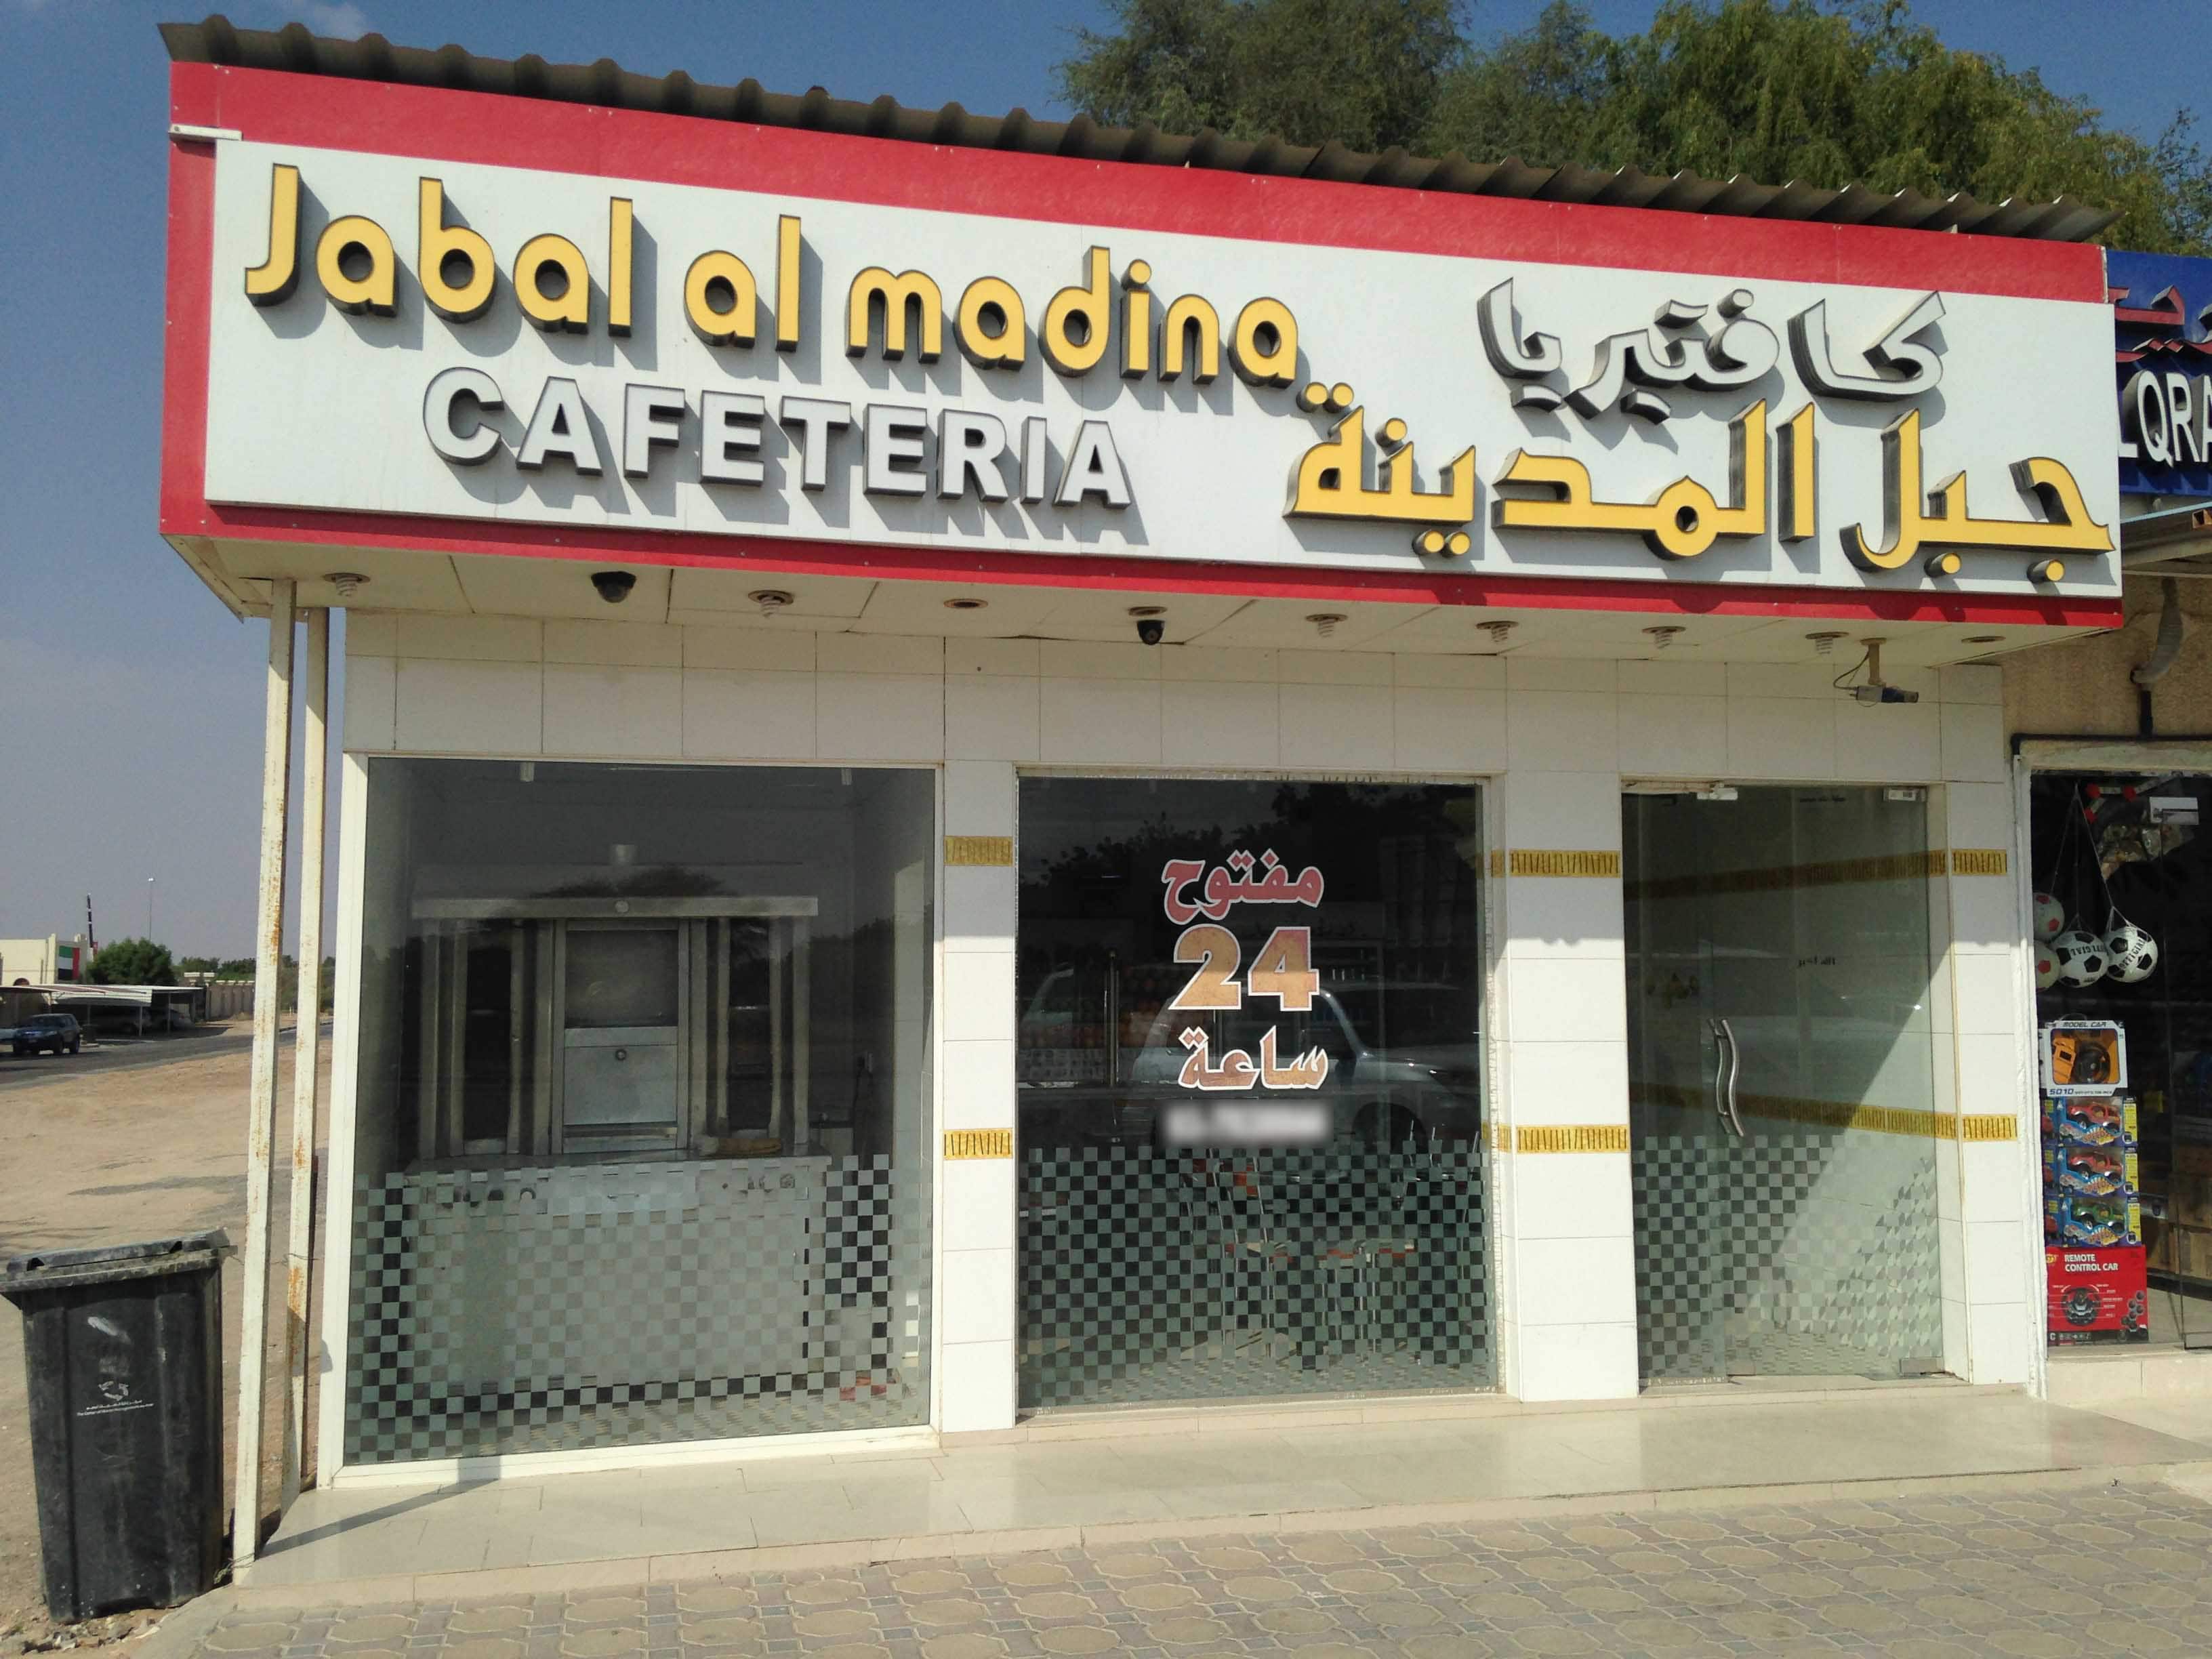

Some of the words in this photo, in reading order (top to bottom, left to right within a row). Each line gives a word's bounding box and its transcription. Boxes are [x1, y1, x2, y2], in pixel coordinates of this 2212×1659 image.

[245, 163, 633, 337] Jabal
[684, 213, 802, 351] al
[846, 245, 1299, 389] madina
[1477, 276, 1948, 424] كافتيريا
[422, 366, 1131, 510] CAFETERIA
[1283, 382, 1816, 561] المدينة
[1840, 407, 2115, 583] جبل
[1162, 848, 1324, 925] مفتوح
[1168, 923, 1320, 1012] 24
[1178, 1025, 1329, 1090] ساعة
[2064, 1254, 2096, 1263] REMOTE
[2065, 1263, 2102, 1272] CONTROL
[2102, 1263, 2118, 1271] CAR
